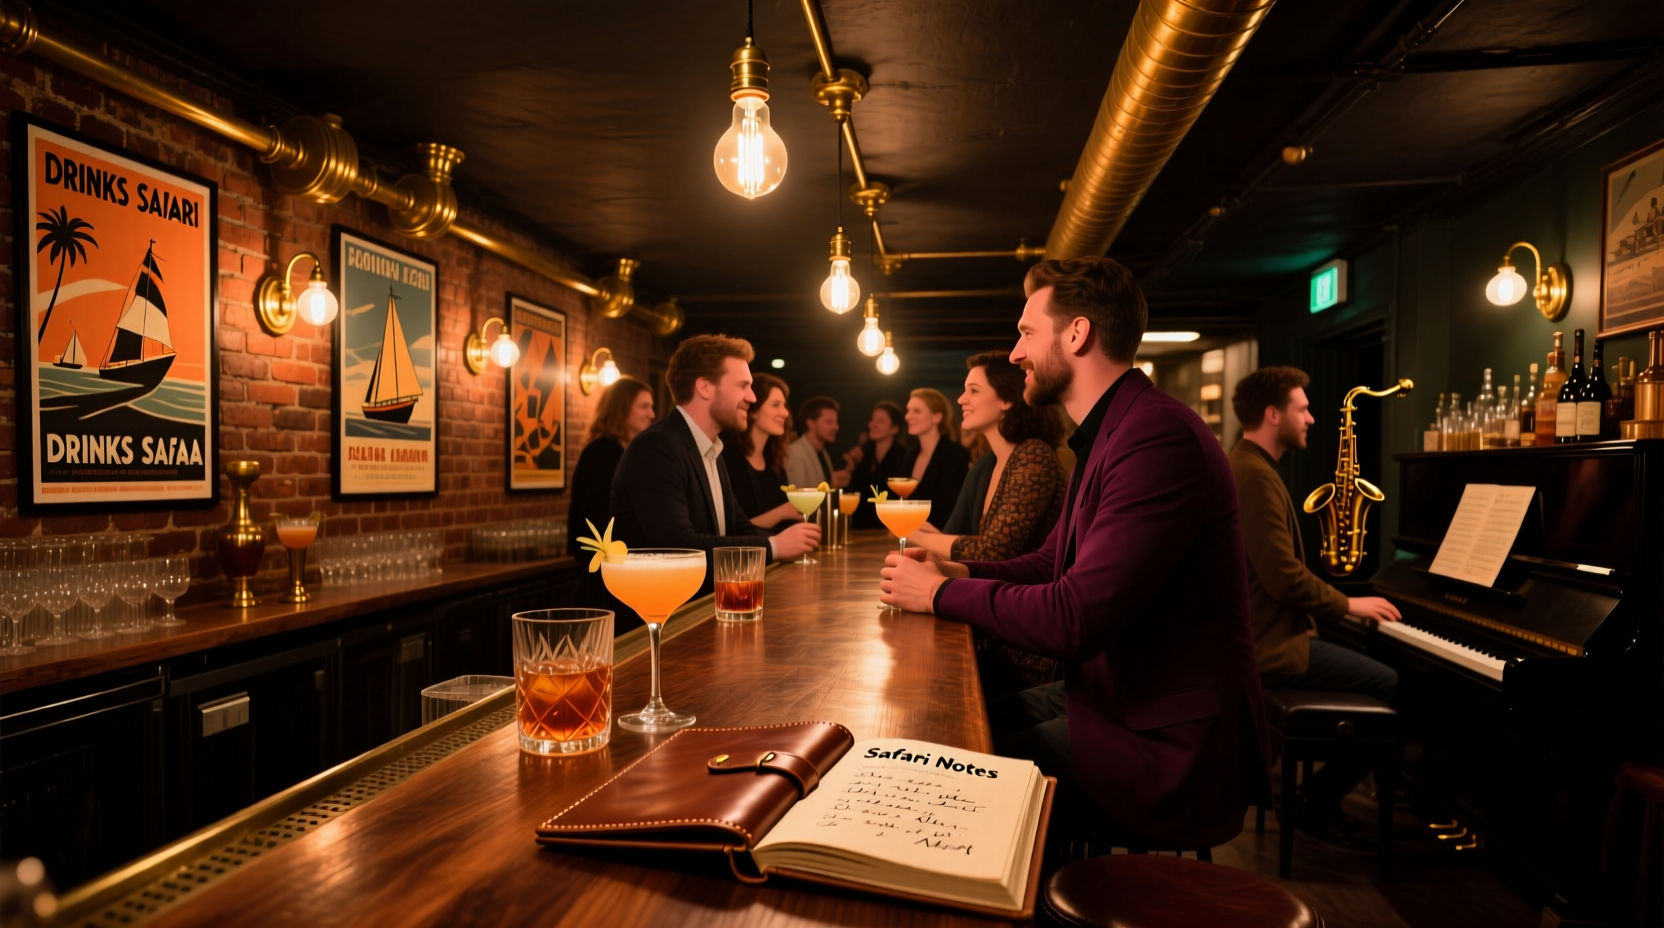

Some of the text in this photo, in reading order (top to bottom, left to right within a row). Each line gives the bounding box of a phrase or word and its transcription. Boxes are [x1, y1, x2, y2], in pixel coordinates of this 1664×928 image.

[45, 151, 129, 206] DRINKS
[46, 433, 134, 465] DRINKS
[864, 747, 931, 766] Safari
[935, 756, 999, 779] Notes
